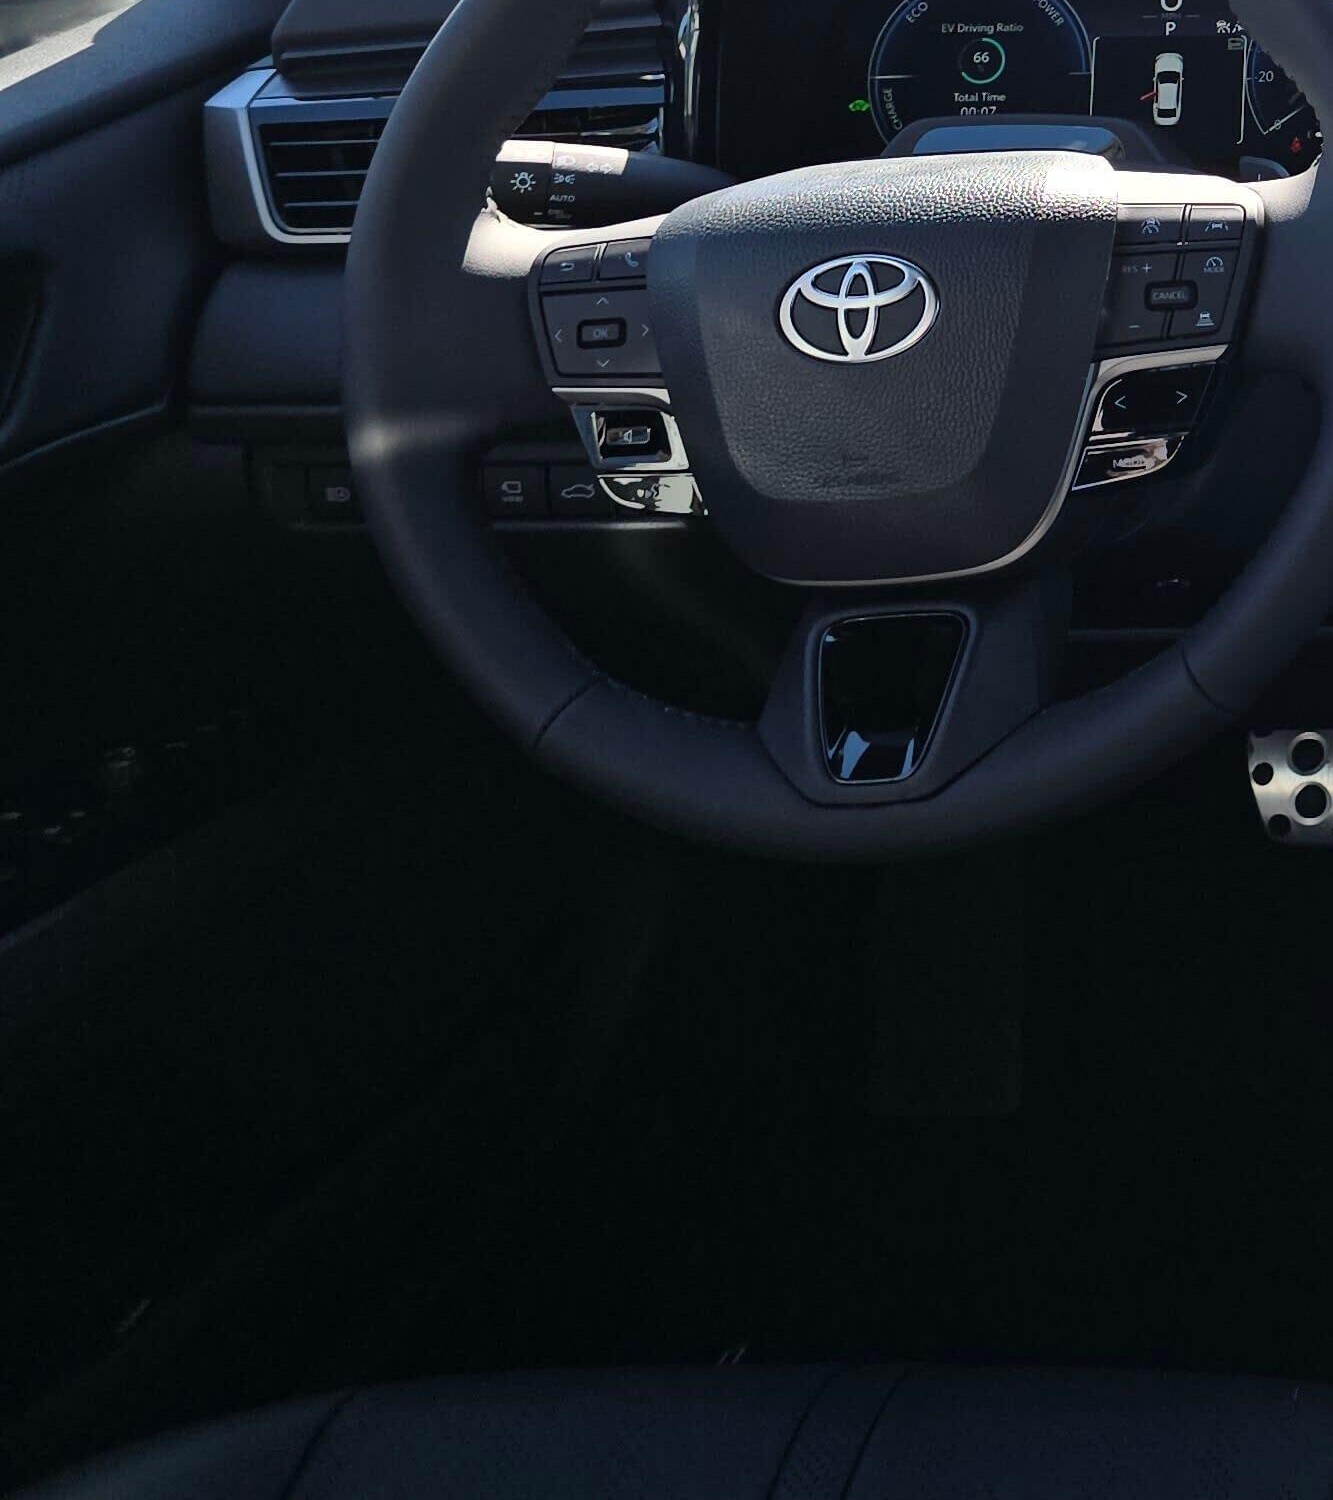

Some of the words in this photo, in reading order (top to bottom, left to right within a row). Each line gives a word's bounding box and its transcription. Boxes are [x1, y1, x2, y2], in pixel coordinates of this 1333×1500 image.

[906, 1, 929, 24] ECO
[941, 23, 955, 33] EV
[957, 23, 994, 35] Driving
[996, 23, 1024, 33] Ratio
[1165, 22, 1176, 36] P
[973, 52, 989, 63] 66
[1258, 71, 1274, 83] 20
[953, 92, 979, 102] Total
[981, 92, 1006, 102] Time
[549, 195, 576, 203] AUTO
[1152, 290, 1185, 300] CANCEL
